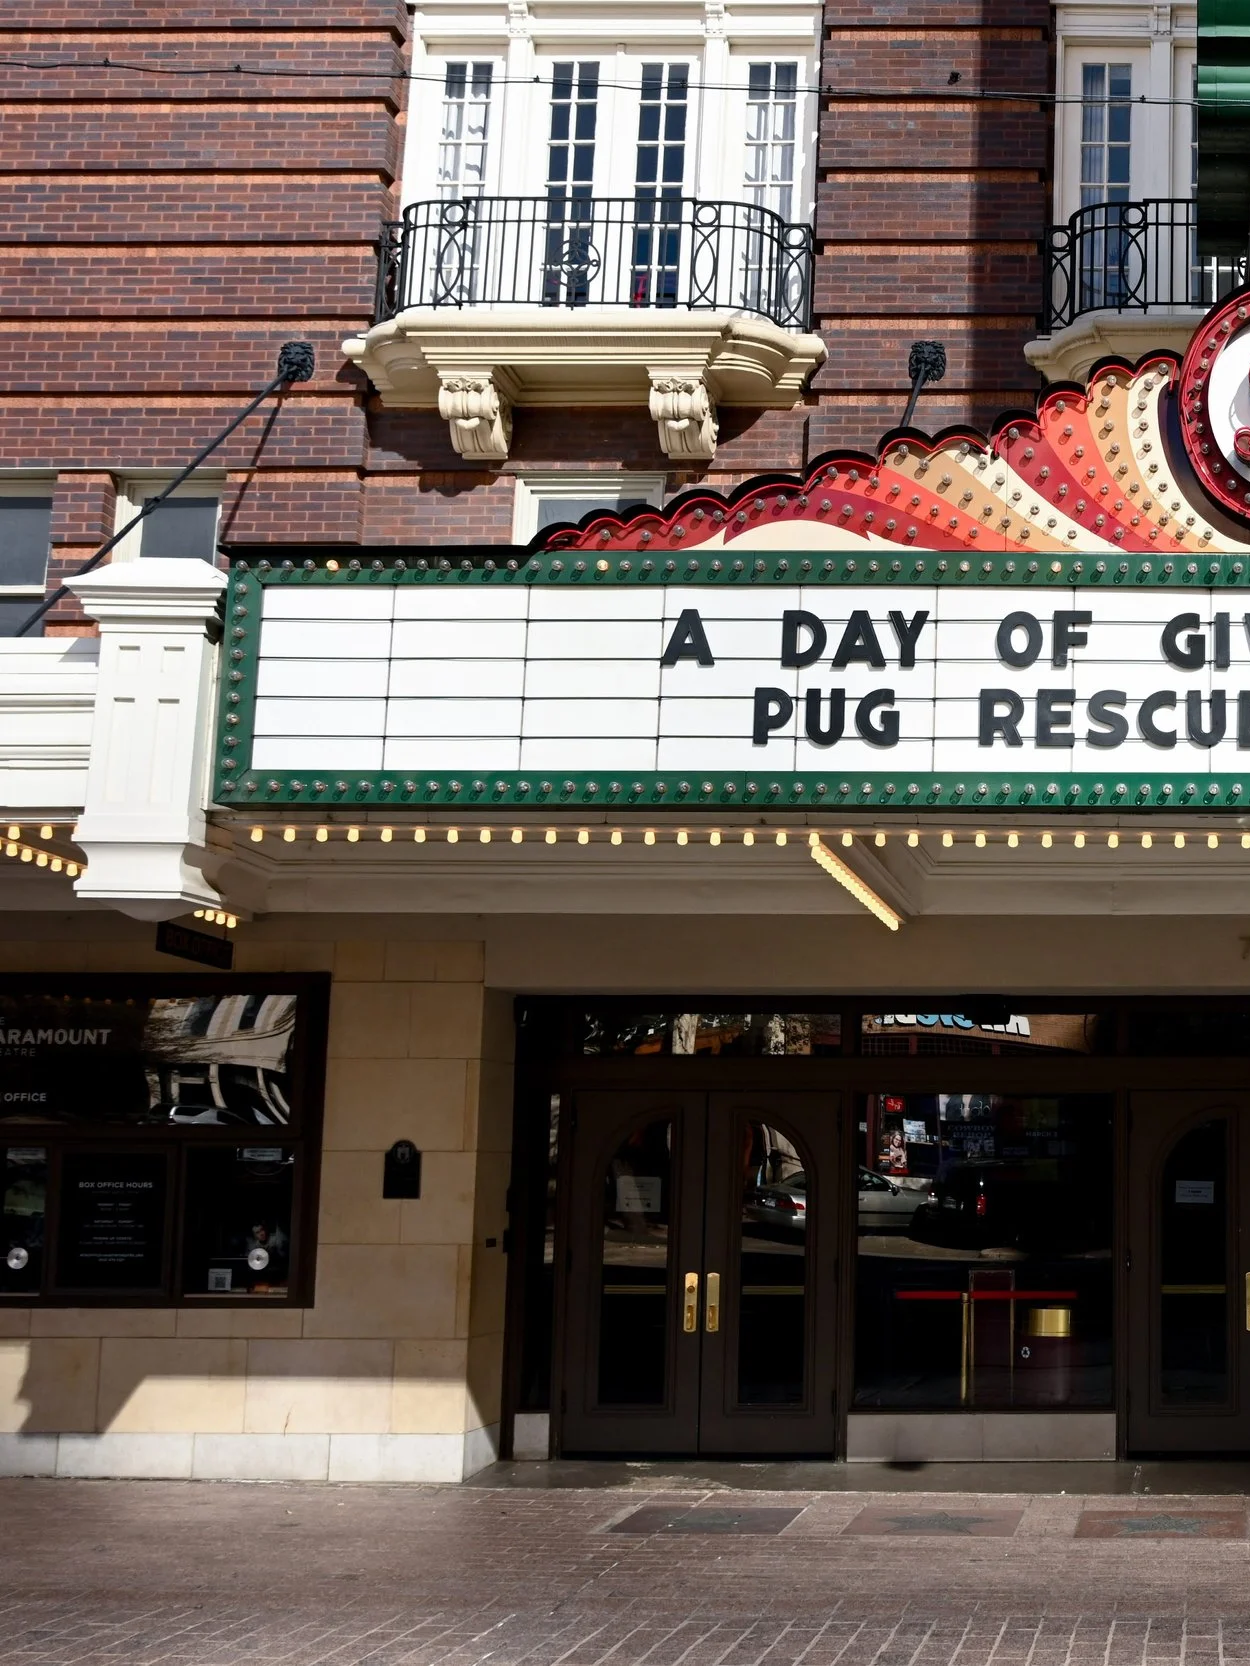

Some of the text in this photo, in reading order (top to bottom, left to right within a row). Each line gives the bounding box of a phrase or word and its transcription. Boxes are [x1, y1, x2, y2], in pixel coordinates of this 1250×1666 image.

[661, 609, 714, 666] A
[782, 611, 929, 668] DAY
[997, 612, 1092, 668] OF
[753, 688, 900, 747] PUG
[0, 1048, 36, 1057] ATRE
[3, 1092, 47, 1103] OFFICE
